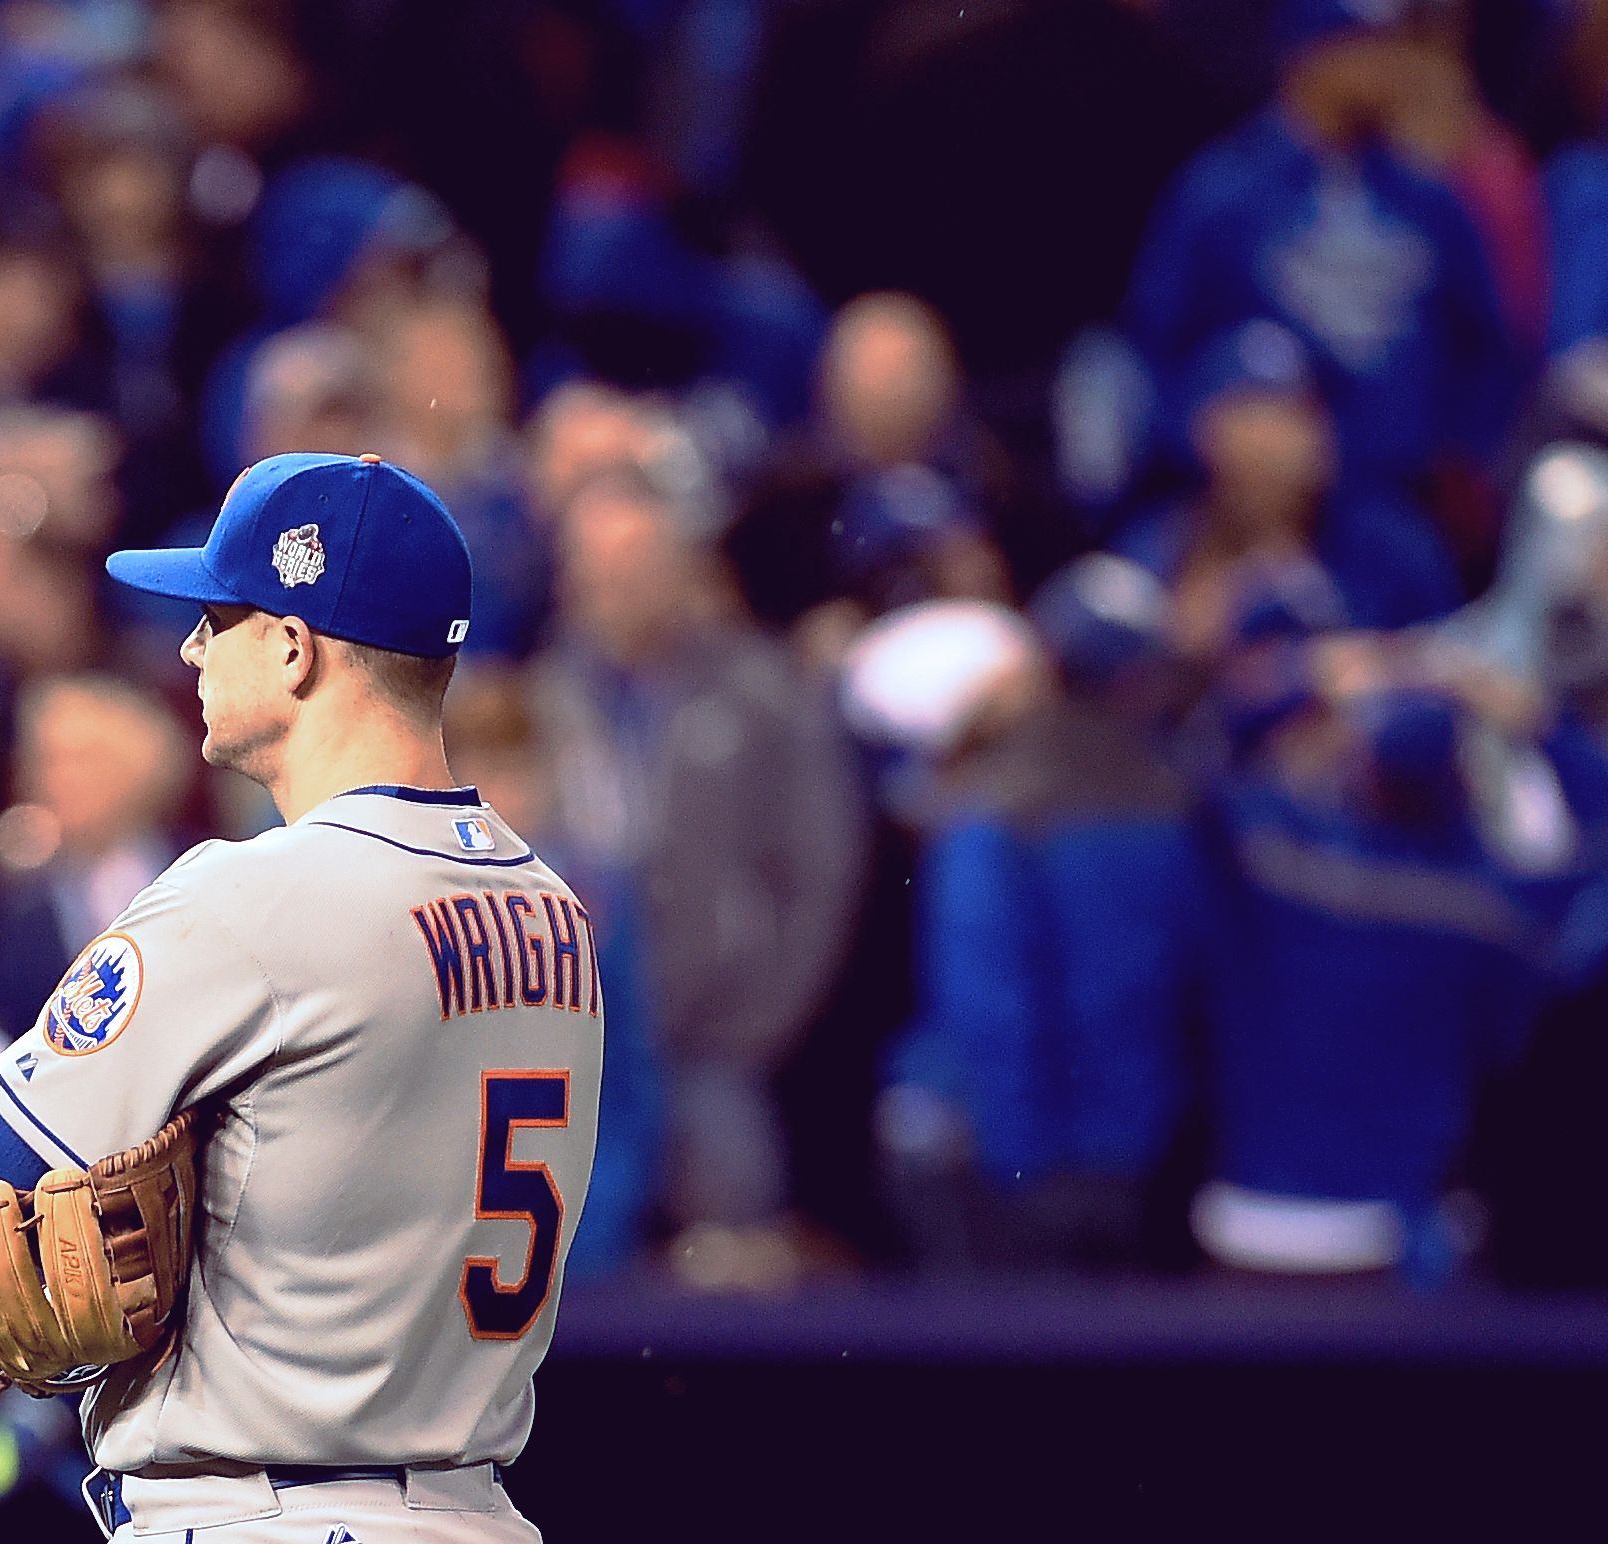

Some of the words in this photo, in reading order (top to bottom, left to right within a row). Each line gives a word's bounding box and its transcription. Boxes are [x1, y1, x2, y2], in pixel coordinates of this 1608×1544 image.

[278, 533, 323, 567] WORLD
[64, 971, 114, 1034] Mets
[410, 889, 598, 1023] WRIGHT
[458, 1067, 571, 1341] 5
